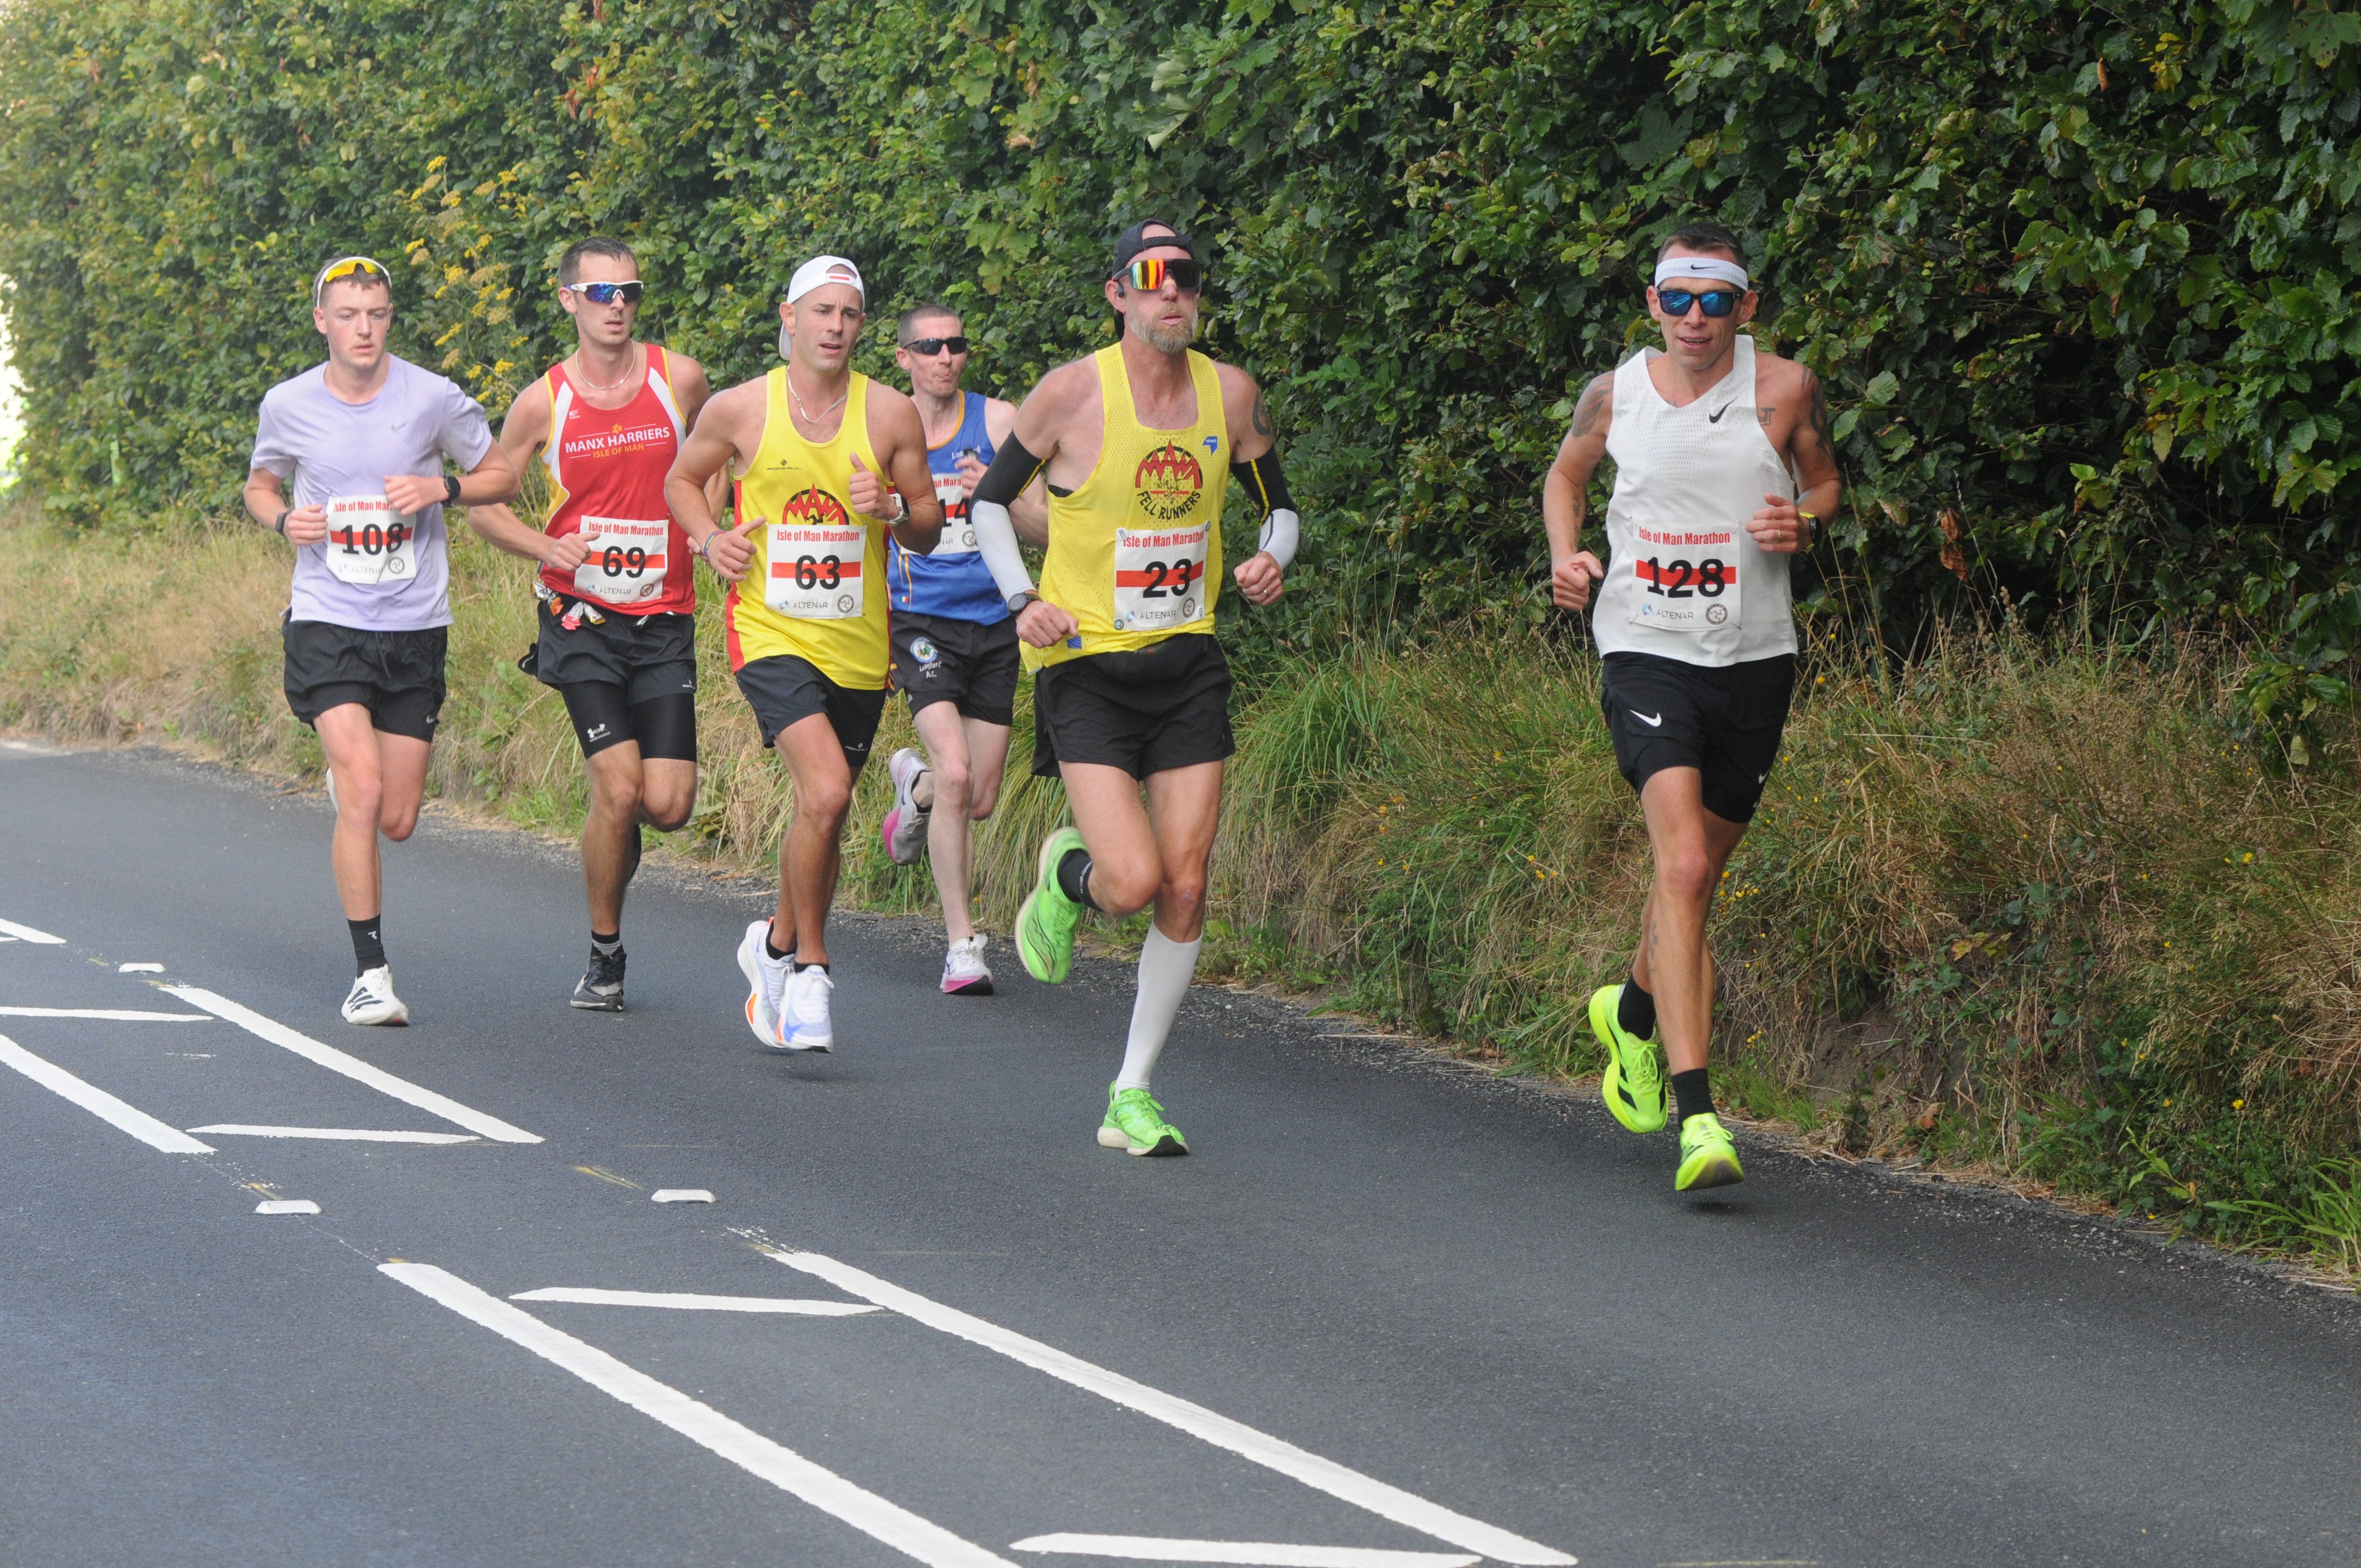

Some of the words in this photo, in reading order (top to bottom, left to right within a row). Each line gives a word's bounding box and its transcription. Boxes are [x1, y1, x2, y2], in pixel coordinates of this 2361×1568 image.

[565, 437, 605, 454] MANX
[607, 426, 670, 447] HARRIERS
[592, 449, 610, 459] ISLE
[611, 447, 623, 455] OF
[624, 443, 645, 453] MAN
[349, 502, 356, 511] of
[358, 501, 374, 511] Man
[938, 497, 973, 527] 14
[1136, 490, 1157, 516] FELL
[1157, 490, 1201, 520] RUNNERS
[340, 522, 404, 556] 108
[589, 521, 602, 532] Isle
[604, 523, 612, 533] of
[613, 524, 629, 535] Man
[630, 525, 663, 536] Marathon
[777, 530, 792, 541] Isle
[794, 530, 802, 541] of
[804, 531, 821, 542] Man
[823, 530, 859, 542] Marathon
[1639, 526, 1651, 542] Isle
[1653, 532, 1661, 544] of
[1663, 532, 1682, 545] Man
[1685, 532, 1730, 545] Marathon
[1123, 535, 1140, 548] Isle
[1142, 536, 1151, 548] of
[1153, 535, 1171, 547] Man
[602, 546, 646, 578] 69
[795, 554, 841, 590] 63
[1143, 558, 1192, 598] 23
[1647, 556, 1725, 598] 128
[1140, 610, 1177, 620] ALTENAR
[1657, 609, 1694, 620] ALTENAR
